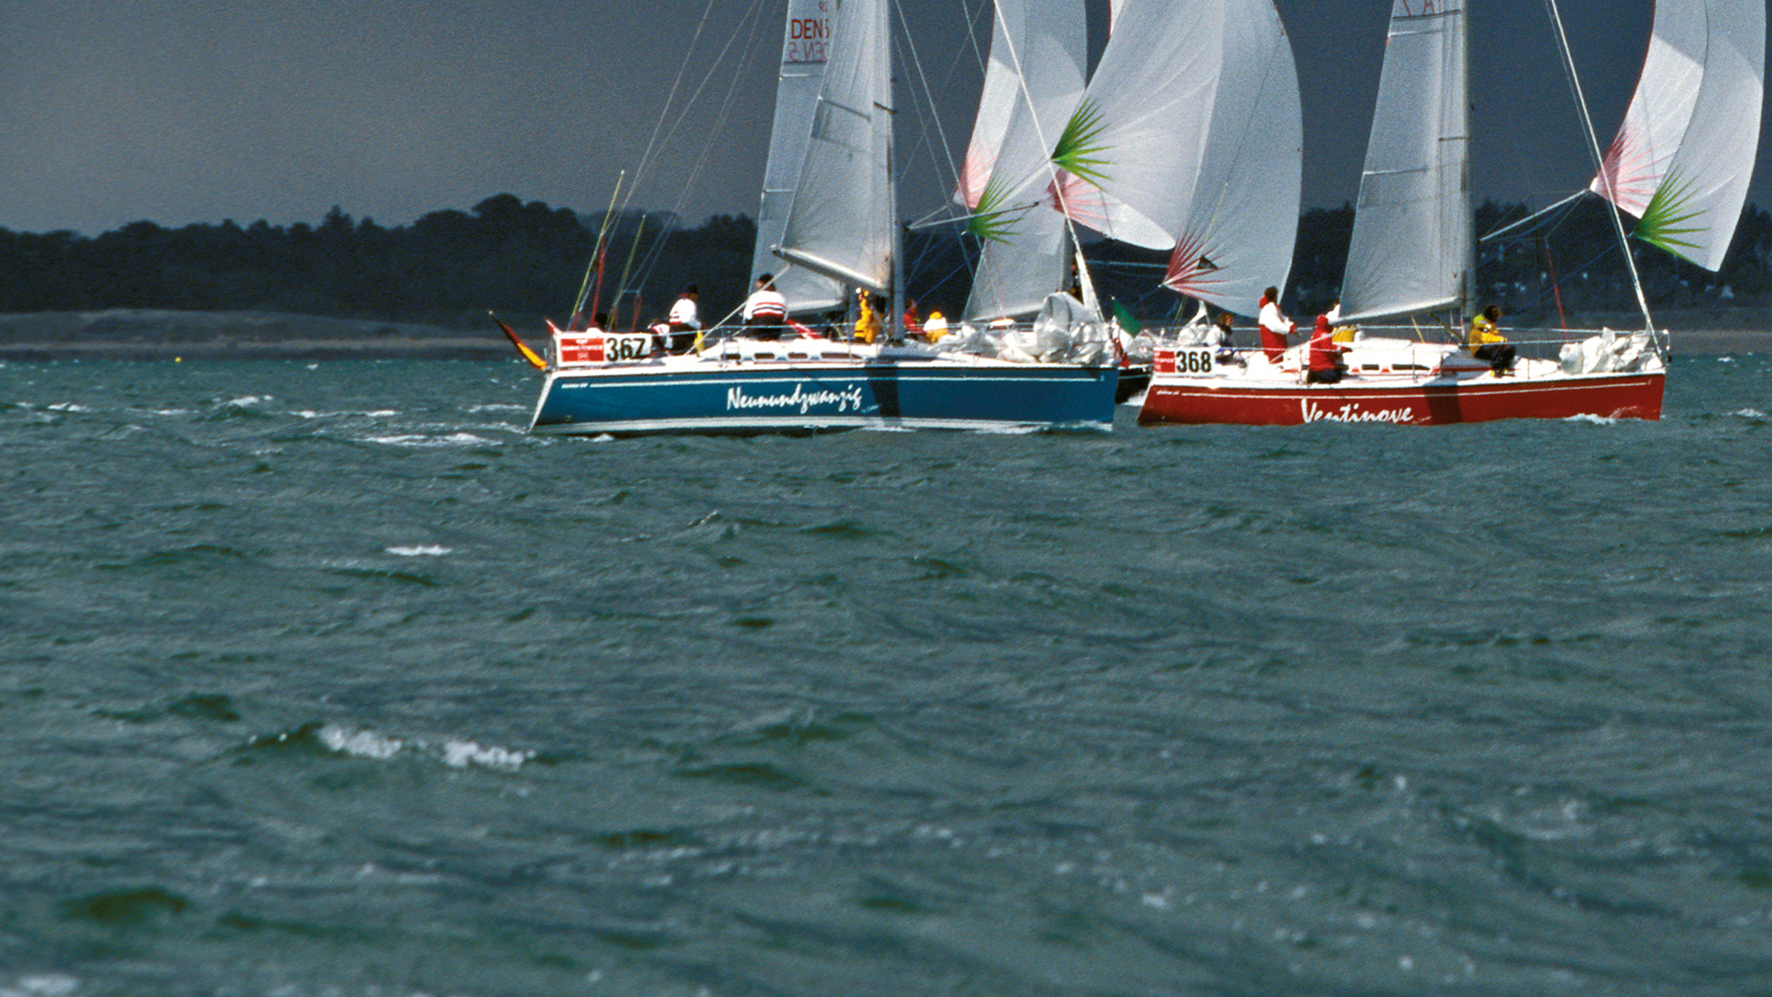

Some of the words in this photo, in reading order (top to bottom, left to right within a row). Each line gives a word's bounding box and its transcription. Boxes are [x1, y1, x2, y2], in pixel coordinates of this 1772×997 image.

[791, 19, 823, 39] DEN
[606, 338, 647, 363] 367
[1176, 350, 1212, 373] 368
[726, 383, 862, 415] Neunundzwanzig
[1301, 398, 1413, 423] Ventinove
